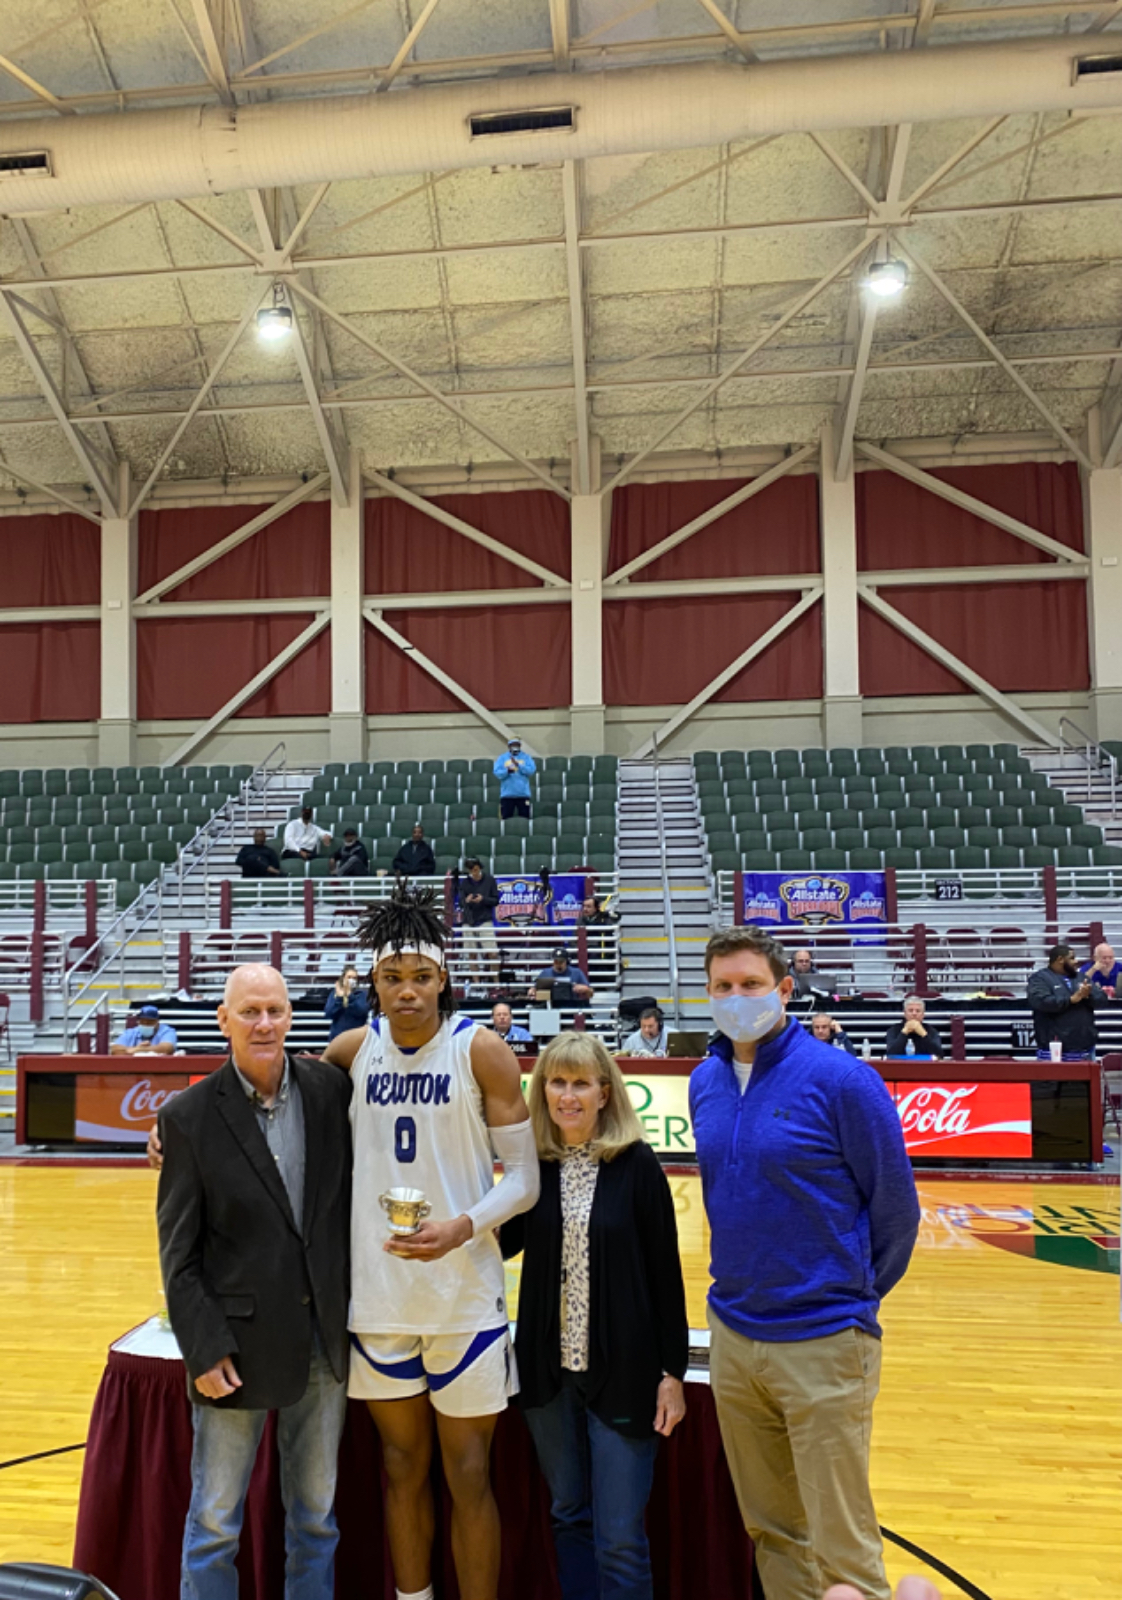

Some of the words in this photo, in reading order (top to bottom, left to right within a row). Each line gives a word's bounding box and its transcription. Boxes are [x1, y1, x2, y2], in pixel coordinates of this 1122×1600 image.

[791, 889, 837, 901] Allstate
[939, 886, 960, 899] 212
[366, 1072, 451, 1106] NEWTON
[394, 1116, 416, 1163] 0
